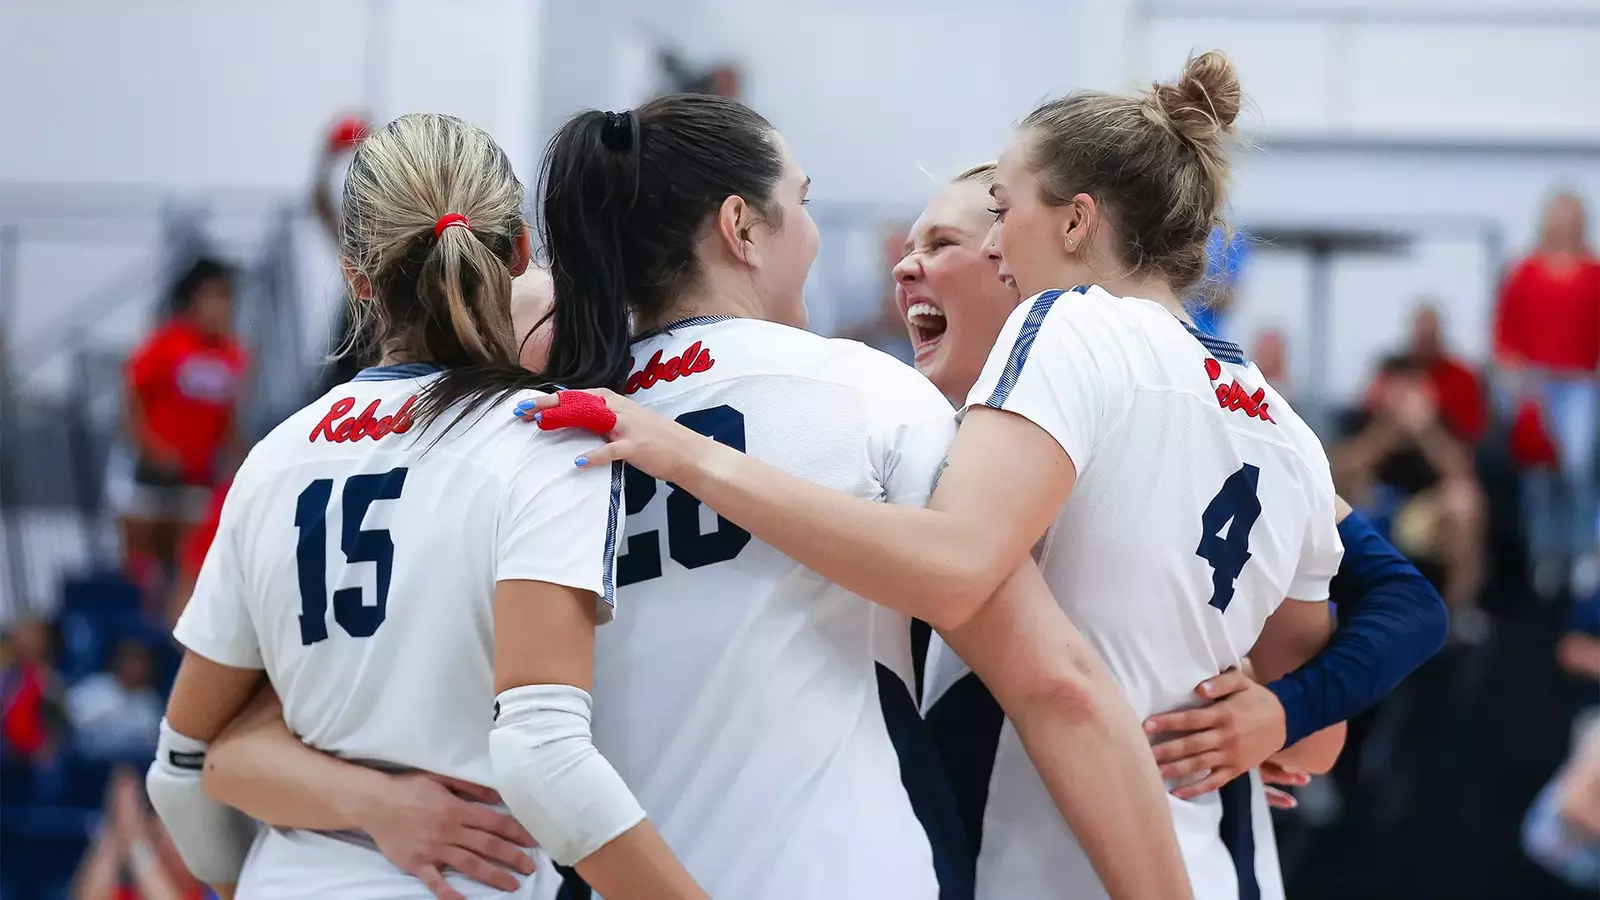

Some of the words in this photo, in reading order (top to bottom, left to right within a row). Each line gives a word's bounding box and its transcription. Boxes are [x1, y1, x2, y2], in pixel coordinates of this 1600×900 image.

[625, 340, 715, 395] ebels
[294, 467, 409, 646] 15
[1195, 462, 1262, 615] 4
